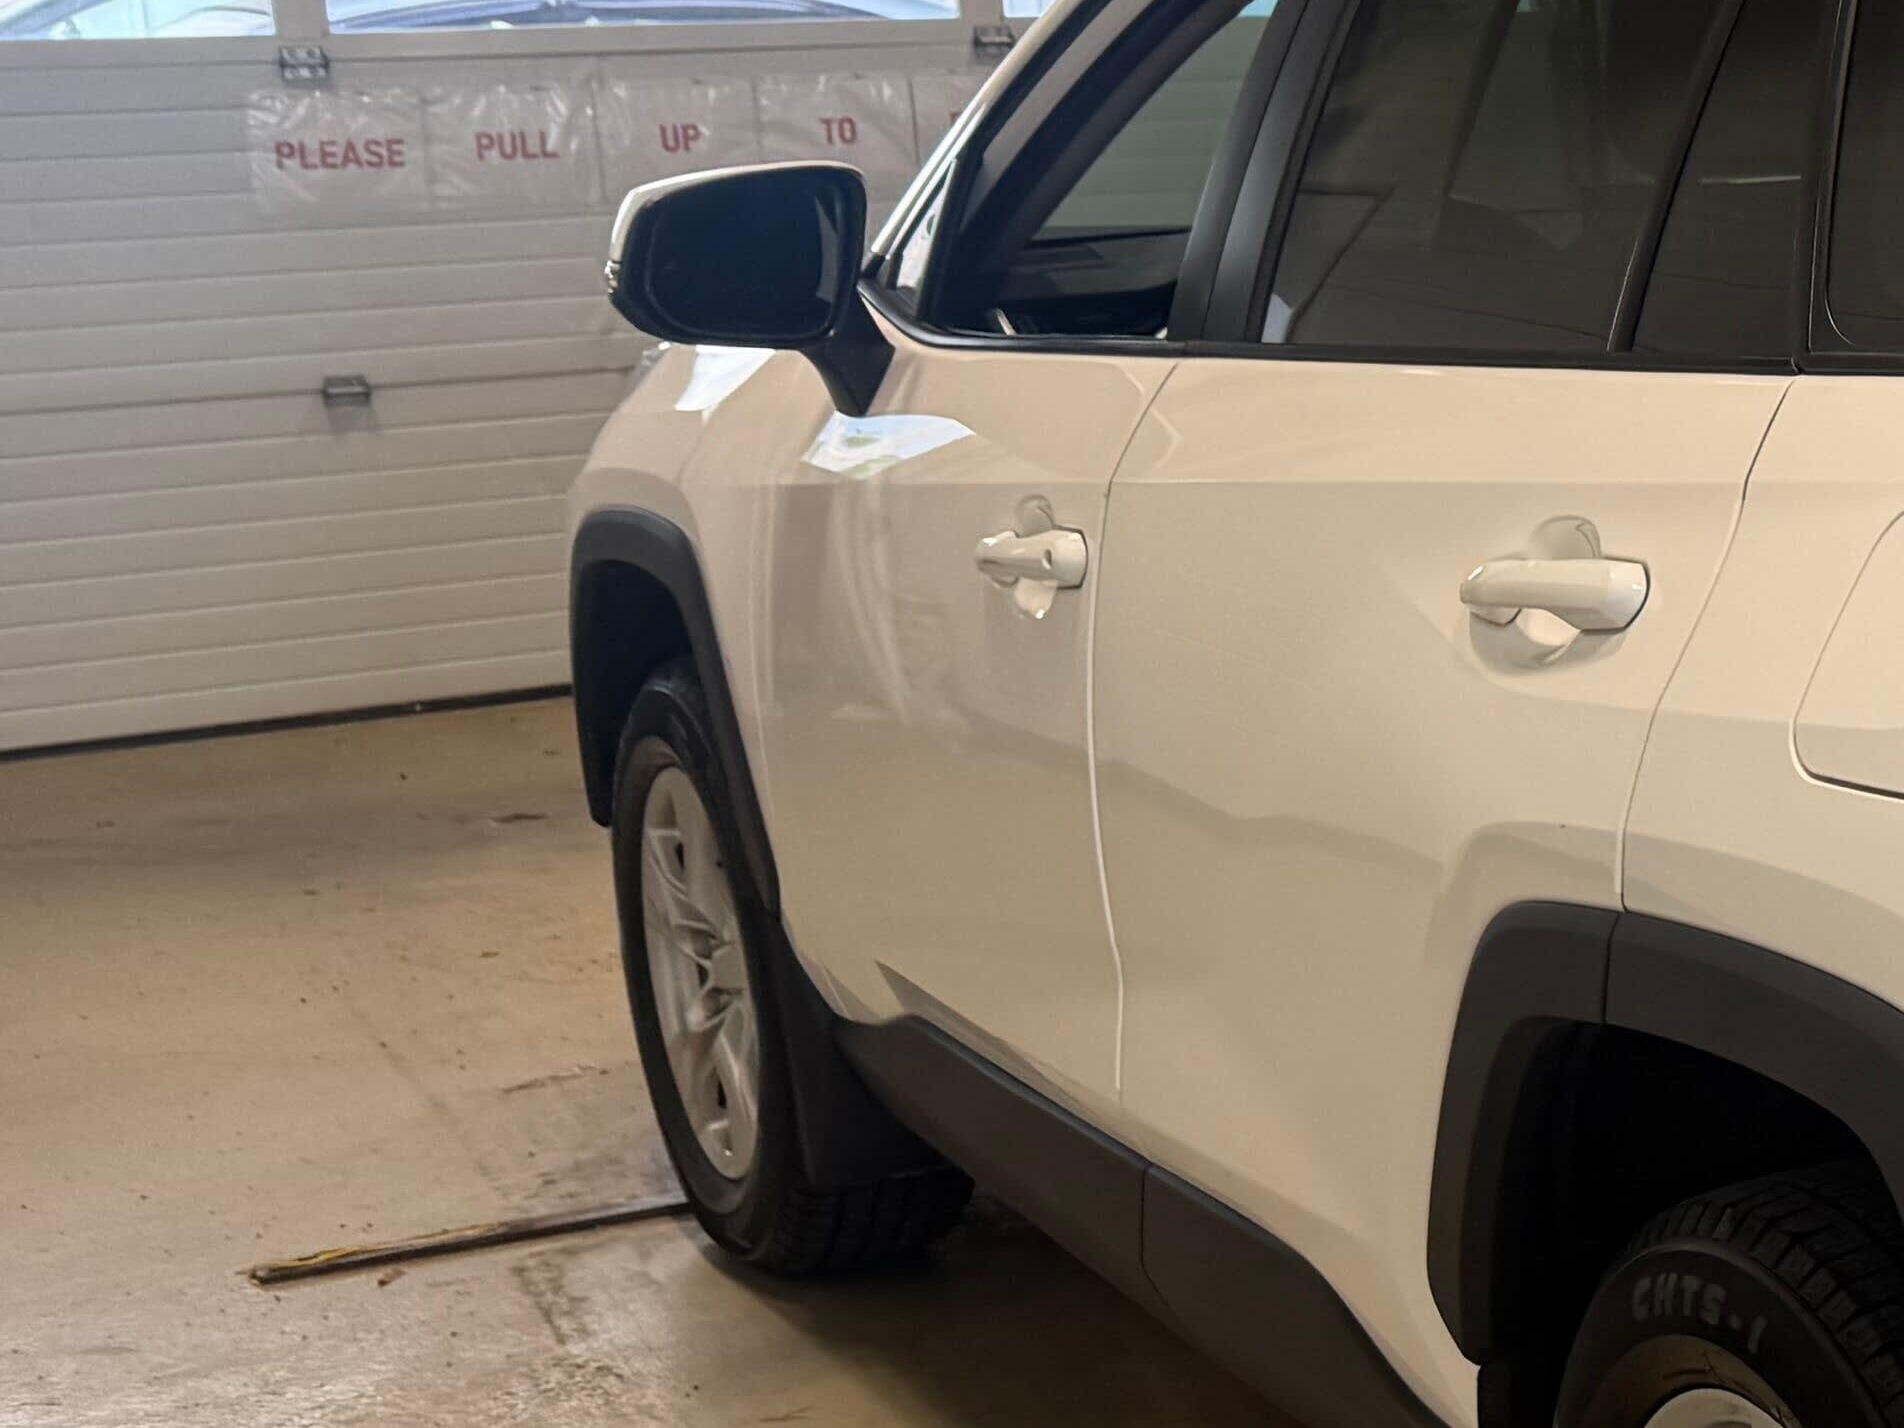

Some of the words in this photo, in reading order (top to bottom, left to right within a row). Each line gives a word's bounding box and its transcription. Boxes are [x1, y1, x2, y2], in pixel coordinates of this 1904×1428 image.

[275, 138, 406, 170] PLEASE
[476, 132, 559, 162] PULL
[660, 123, 702, 153] UP
[819, 116, 858, 145] TO
